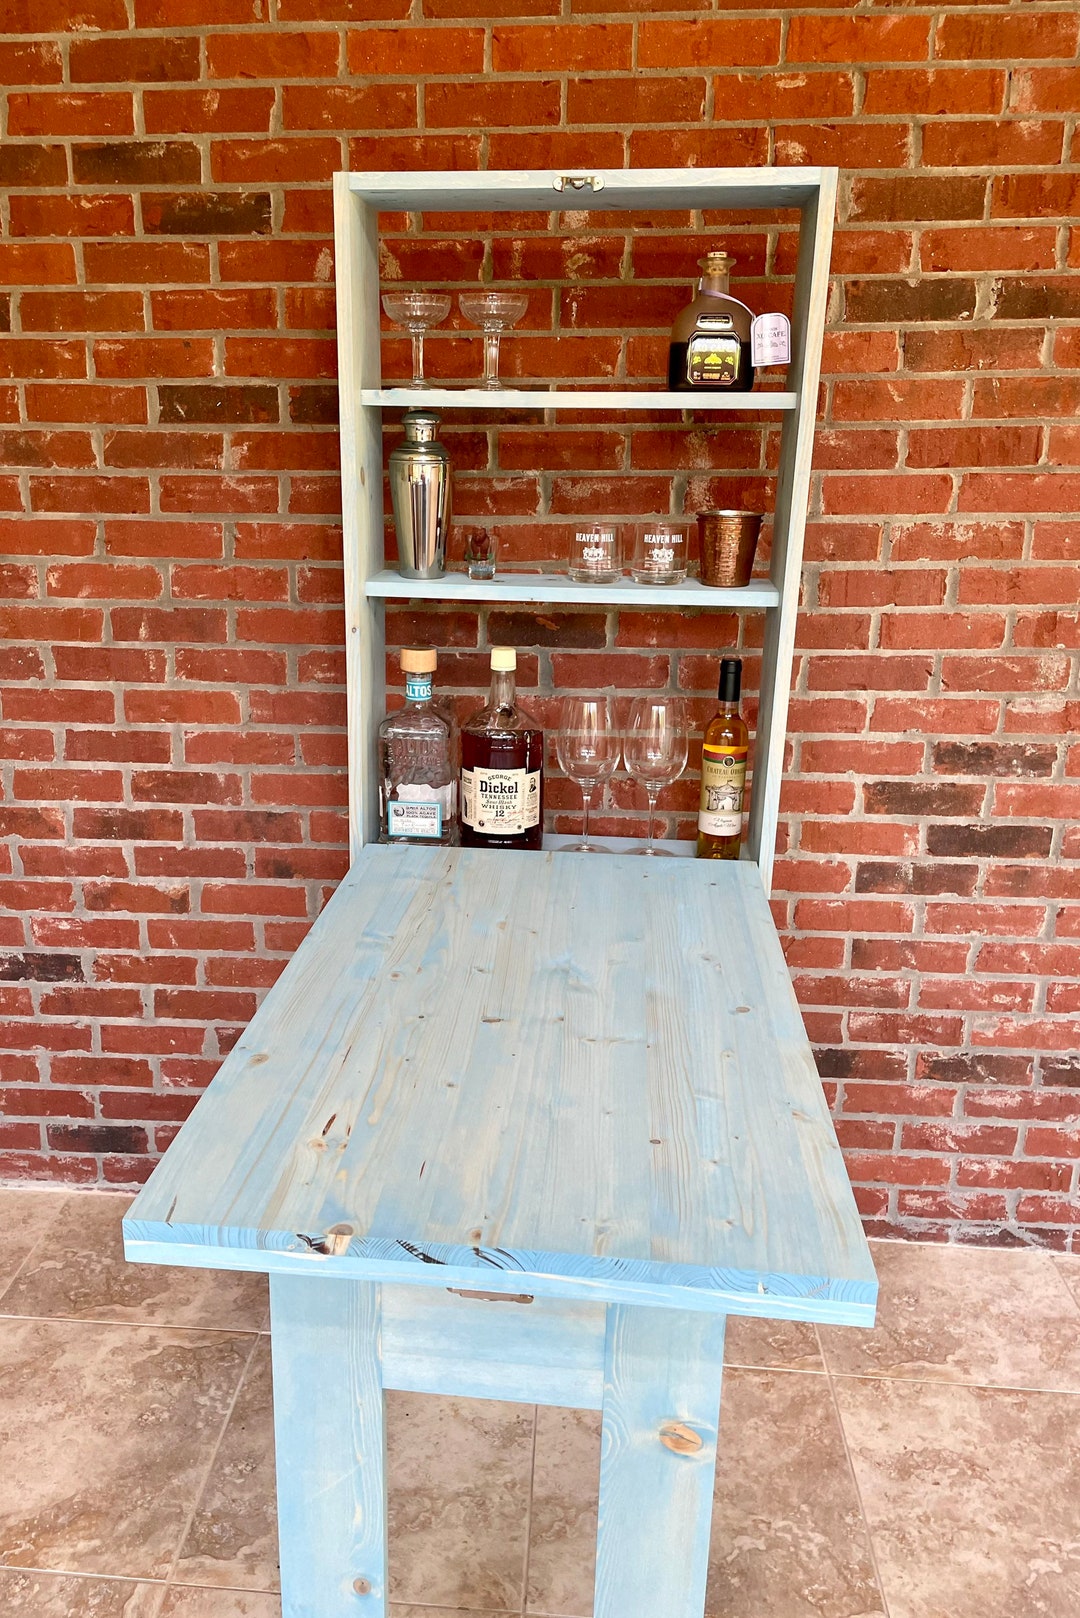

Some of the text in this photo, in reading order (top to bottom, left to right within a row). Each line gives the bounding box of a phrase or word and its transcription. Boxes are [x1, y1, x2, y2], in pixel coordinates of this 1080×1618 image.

[576, 533, 614, 543] HEAVEN HILL
[644, 534, 683, 543] HEAVEN HILL
[406, 685, 432, 697] ALTOS
[480, 780, 518, 794] Dickel
